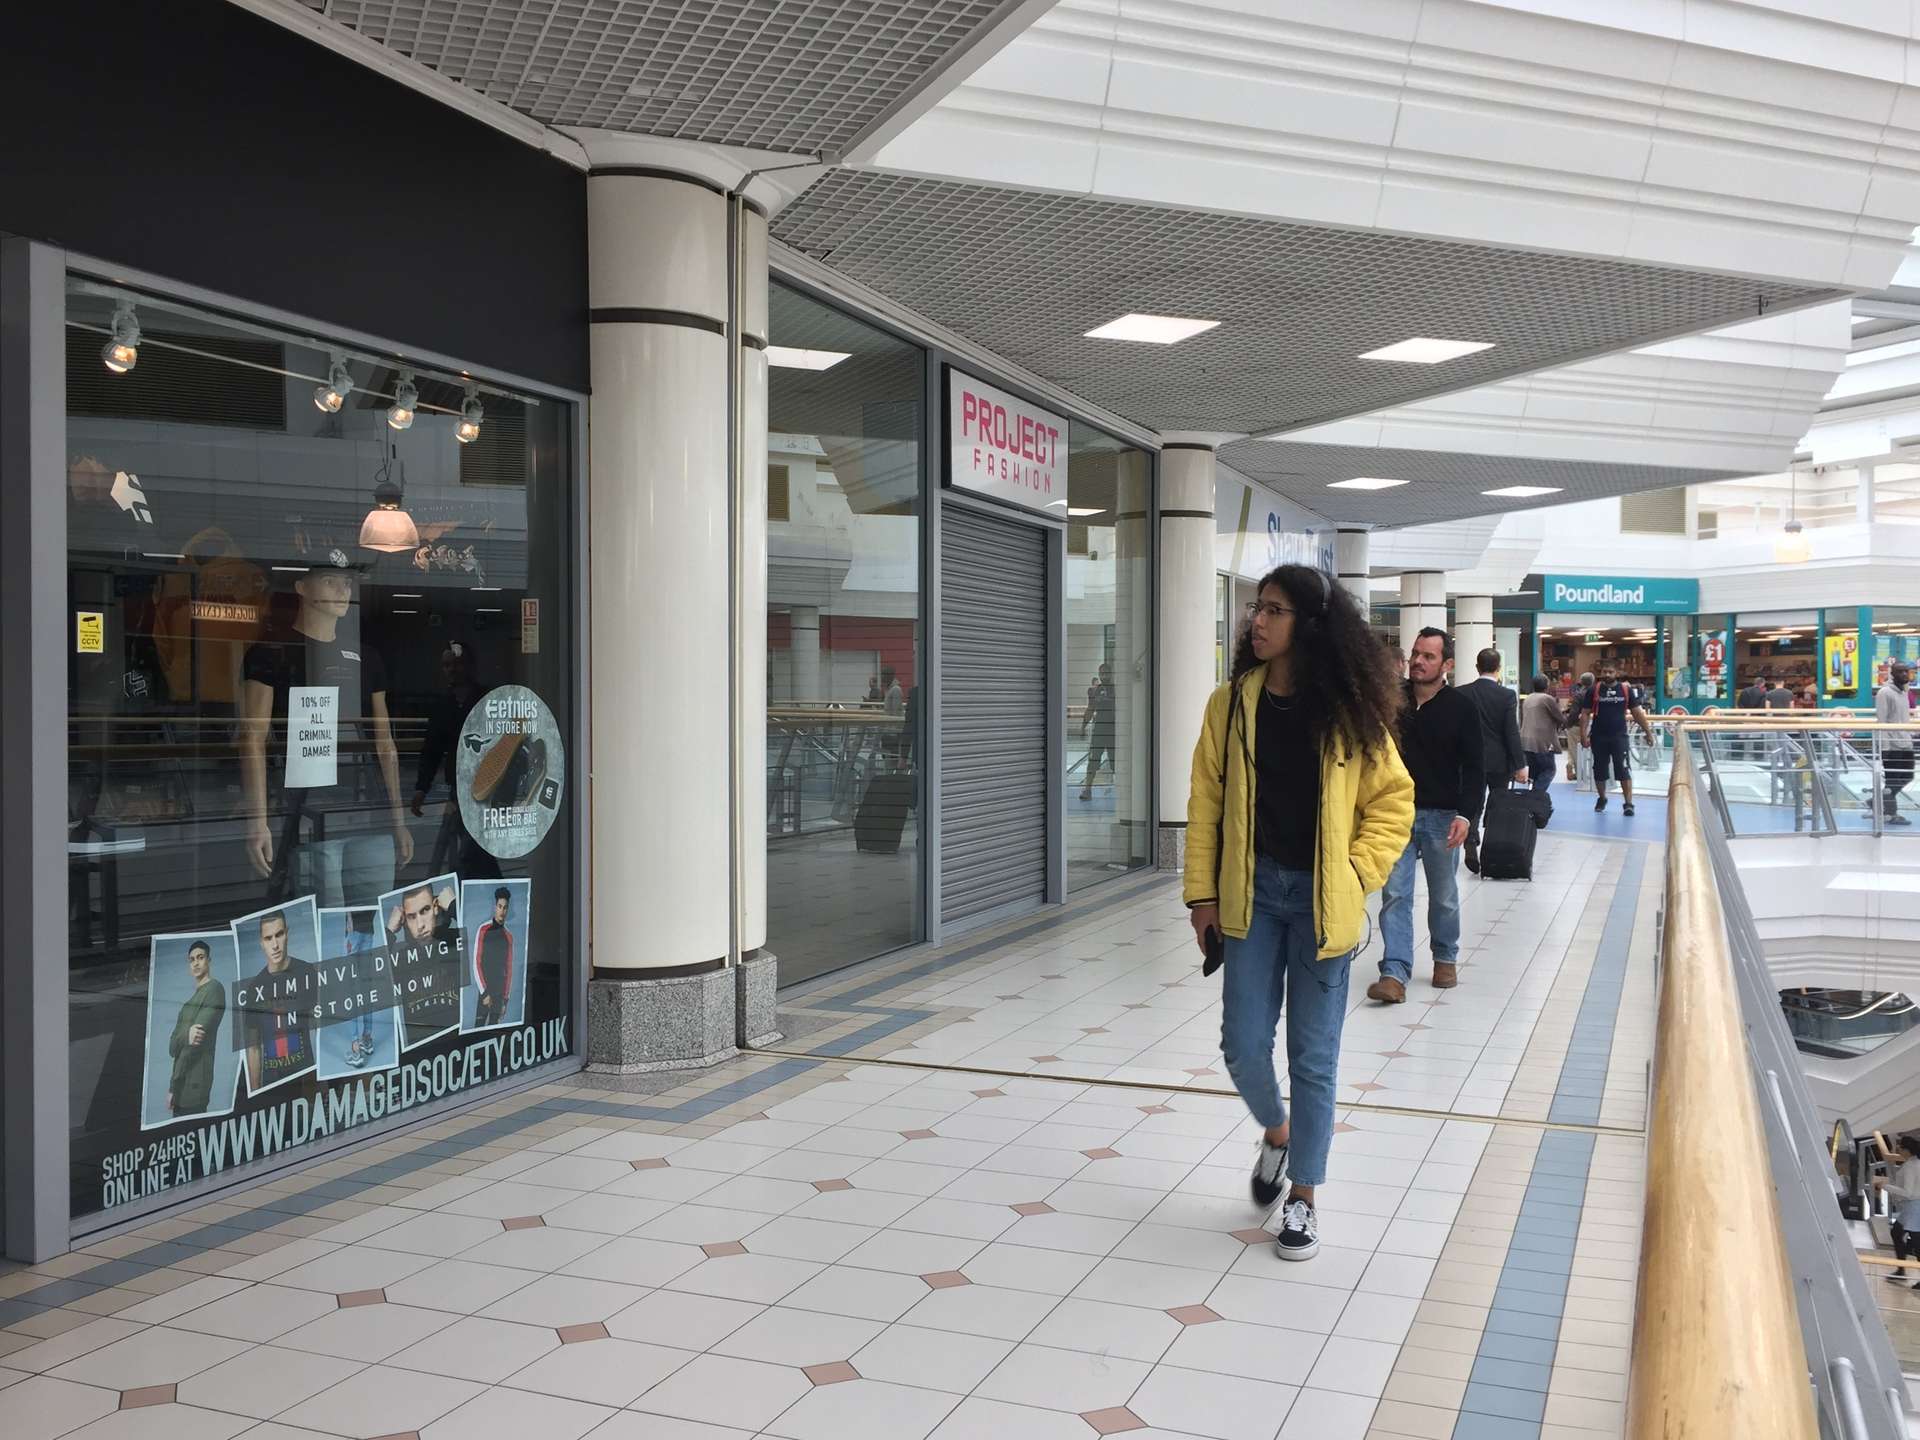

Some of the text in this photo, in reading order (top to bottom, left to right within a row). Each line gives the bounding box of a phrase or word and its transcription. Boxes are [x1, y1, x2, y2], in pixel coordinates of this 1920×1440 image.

[963, 390, 1058, 469] PROJECT
[974, 448, 1050, 494] FASHION
[1555, 583, 1644, 604] Poundland
[81, 637, 100, 646] CCTV
[1705, 643, 1722, 661] £1
[301, 696, 331, 708] 10% OFF
[310, 713, 324, 725] ALL
[486, 720, 538, 735] IN STORE NOW
[299, 729, 332, 742] CRIMINAL
[302, 745, 331, 758] DAMAGE
[483, 806, 512, 829] FREE
[512, 812, 537, 826] OR BAG
[276, 1010, 298, 1029] IN
[313, 989, 379, 1019] STORE
[393, 974, 434, 997] NOW
[102, 1130, 196, 1180] SHOP 24HRS
[103, 1153, 195, 1209] ONLINE AT
